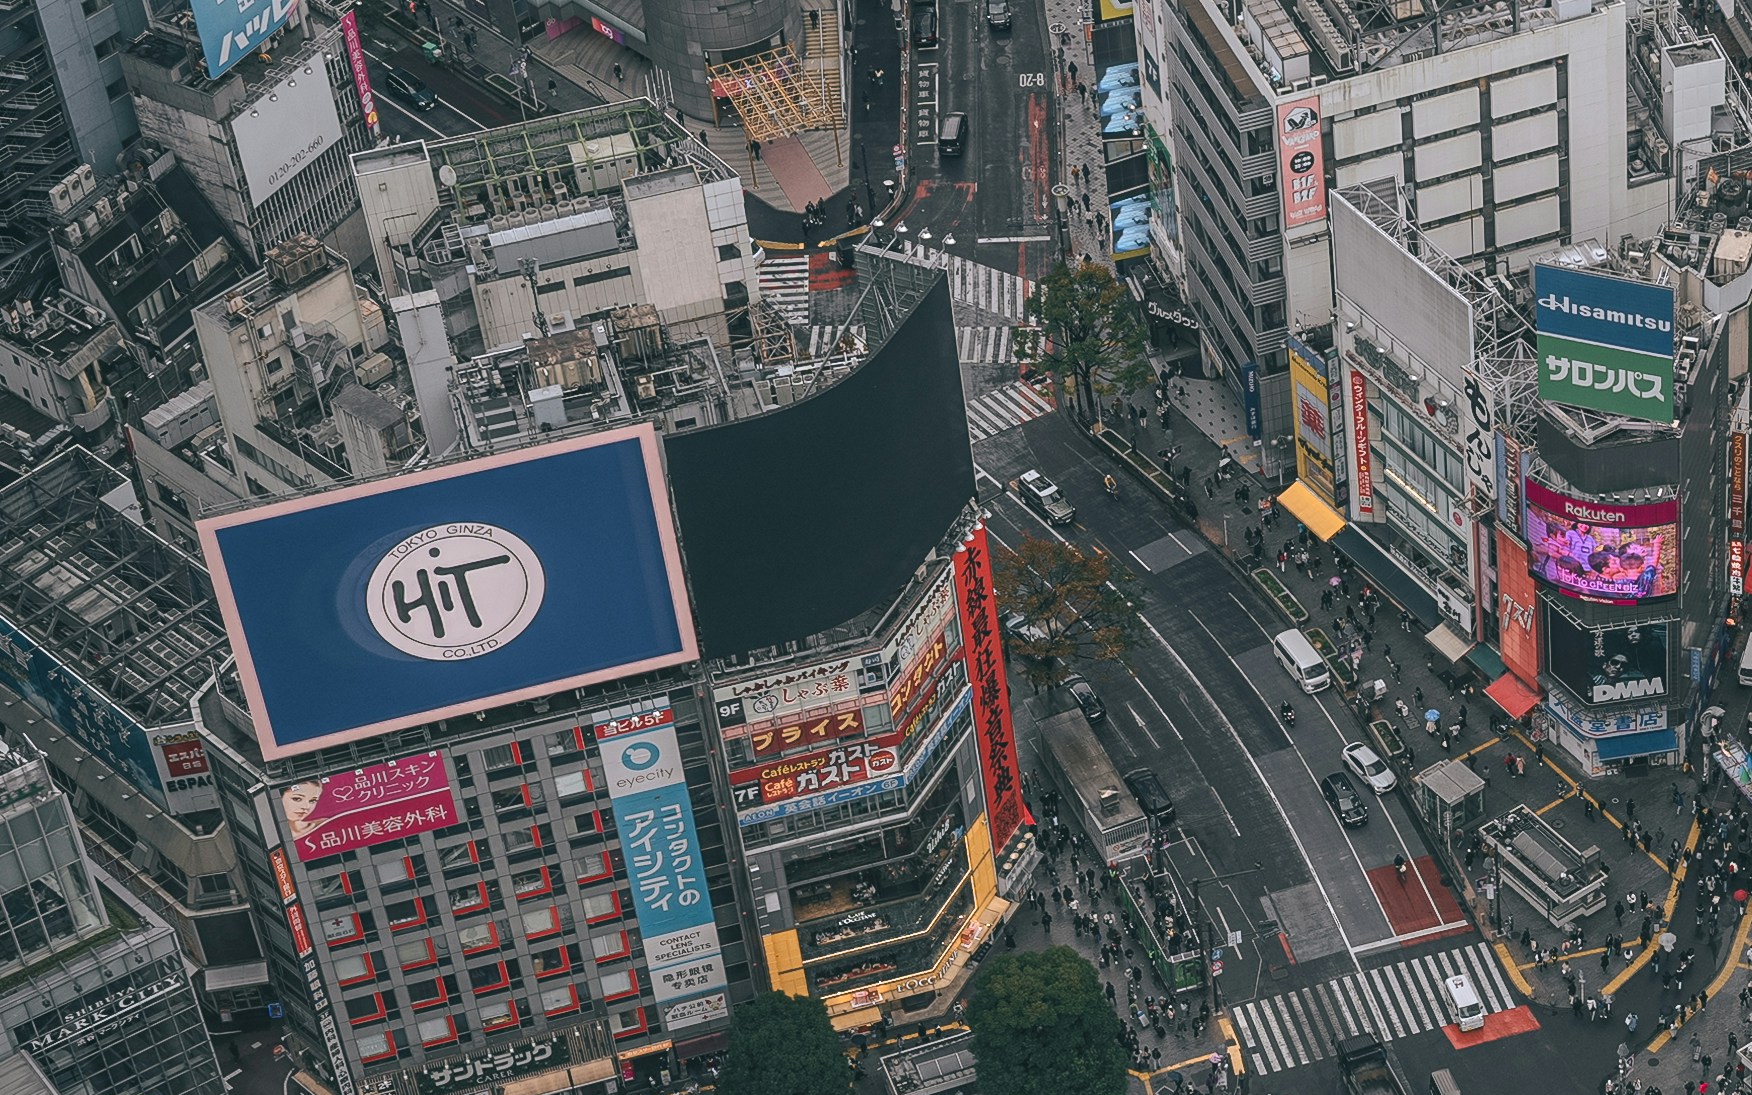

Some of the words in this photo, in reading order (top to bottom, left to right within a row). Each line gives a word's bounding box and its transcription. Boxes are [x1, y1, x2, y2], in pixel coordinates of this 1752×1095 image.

[1019, 72, 1045, 88] 8-20
[268, 135, 324, 186] 0120-202-660
[1292, 175, 1315, 191] B1F
[1149, 301, 1199, 330] グルメタウン
[1538, 293, 1671, 332] Hisamitsu
[1247, 371, 1256, 393] MIZUHO
[1545, 354, 1665, 402] サロンパス
[1301, 398, 1326, 440] 薬
[1352, 384, 1368, 466] ウィンターフルーツギフト
[1464, 376, 1494, 494] もんじゃ
[1565, 502, 1625, 522] Rakuten
[389, 529, 438, 560] TOKYO
[446, 525, 493, 538] GINZA
[1558, 567, 1588, 588] TOKYO
[1589, 577, 1622, 592] GREEN
[1579, 594, 1598, 603] Rakuten
[732, 661, 850, 697] しゃぶしゃぶバイキング
[782, 674, 849, 705] しゃぶ葉
[891, 642, 943, 717] コンタクト
[936, 660, 961, 698] ガスト
[1593, 677, 1664, 702] DMM
[719, 702, 740, 717] 9F
[752, 712, 859, 751] プライス
[354, 761, 436, 789] 品川スキン
[761, 757, 826, 779] Caféレストラン
[829, 742, 879, 765] ガスト
[871, 757, 894, 769] ガスト
[357, 776, 430, 803] クリニック
[616, 767, 674, 788] eyecity
[764, 779, 794, 792] Café
[796, 763, 861, 793] ガスト
[883, 780, 898, 790] 6F
[734, 787, 760, 803] 7F
[319, 804, 447, 850] 品川美容外科
[624, 809, 674, 912] アイシティ
[660, 803, 700, 906] コンタクトの
[654, 942, 712, 961] SPECIALISTS
[660, 931, 701, 946] CONTACT
[671, 940, 693, 951] LENS
[31, 1008, 108, 1050] MARK
[118, 974, 179, 1009] CITY
[64, 986, 134, 1022] SHIBUYA
[430, 1042, 553, 1087] サンドラッグ
[476, 1069, 514, 1084] CARER
